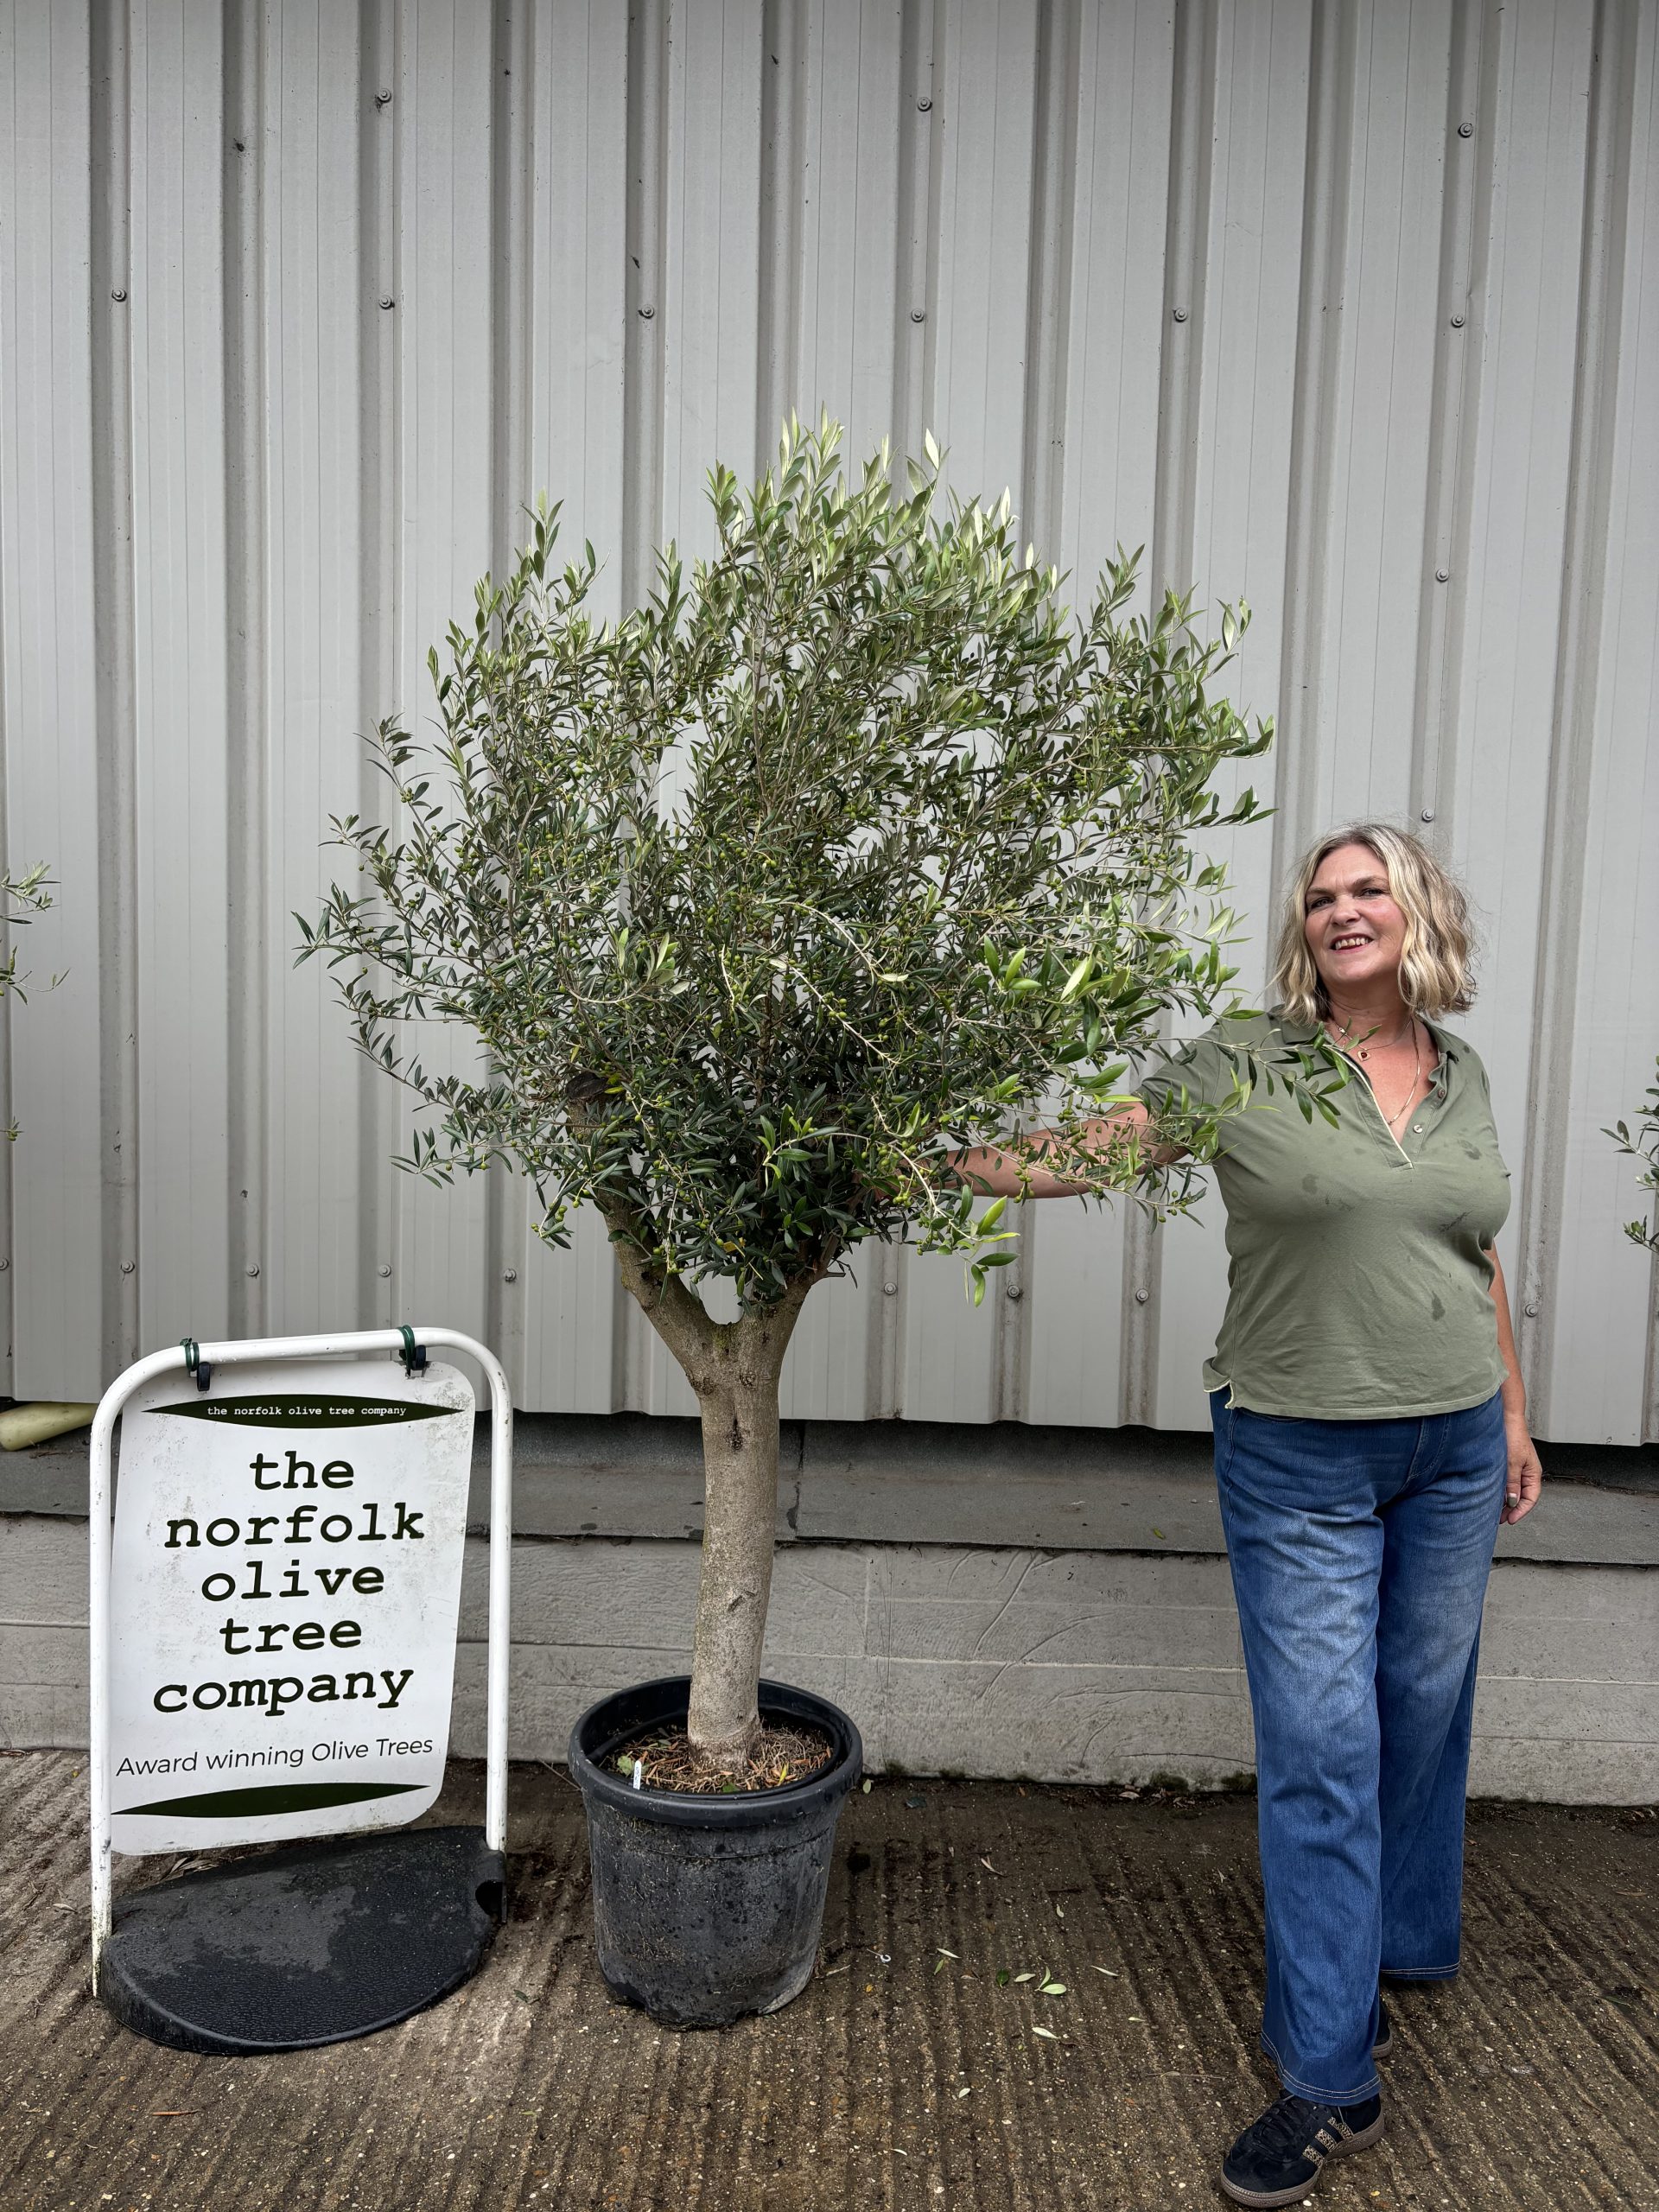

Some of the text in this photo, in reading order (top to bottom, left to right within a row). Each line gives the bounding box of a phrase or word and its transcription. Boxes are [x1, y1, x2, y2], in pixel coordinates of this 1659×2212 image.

[207, 1406, 407, 1417] the norfolk olive tree company
[250, 1451, 353, 1490] the
[164, 1503, 424, 1548] norfolk
[202, 1560, 384, 1601] olive
[219, 1618, 361, 1655] tree
[154, 1669, 414, 1716] company
[117, 1738, 432, 1776] Award winning Olive Trees
